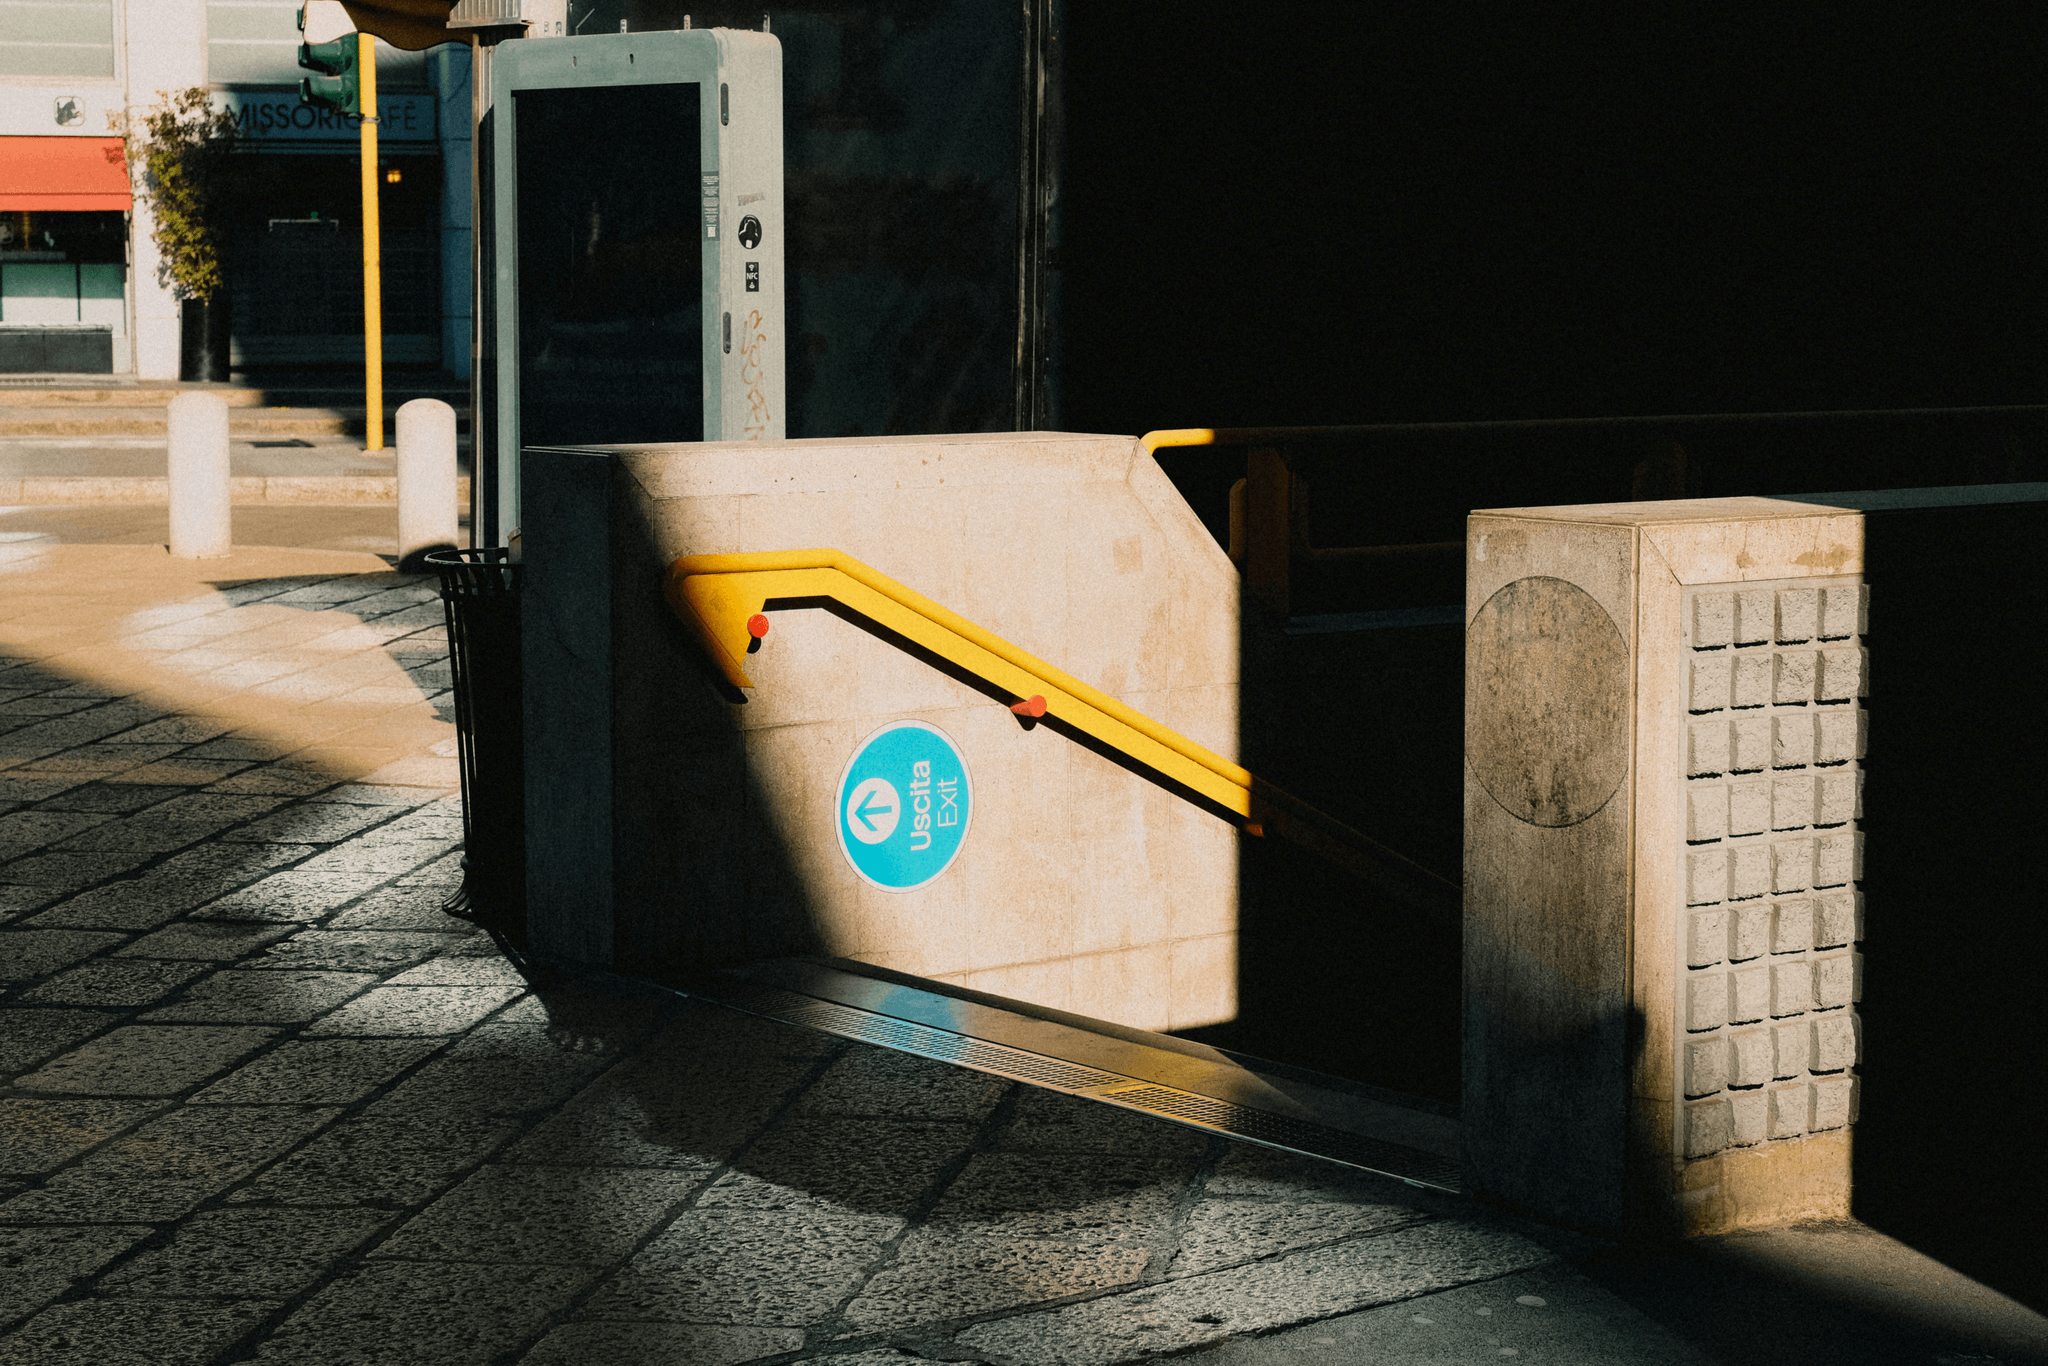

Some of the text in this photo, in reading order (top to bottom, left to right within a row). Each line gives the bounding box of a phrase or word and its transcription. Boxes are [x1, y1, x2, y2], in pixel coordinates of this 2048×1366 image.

[225, 103, 342, 130] MISSORI
[746, 272, 759, 280] NFC
[910, 760, 932, 851] Uscita
[937, 776, 958, 828] Exit
